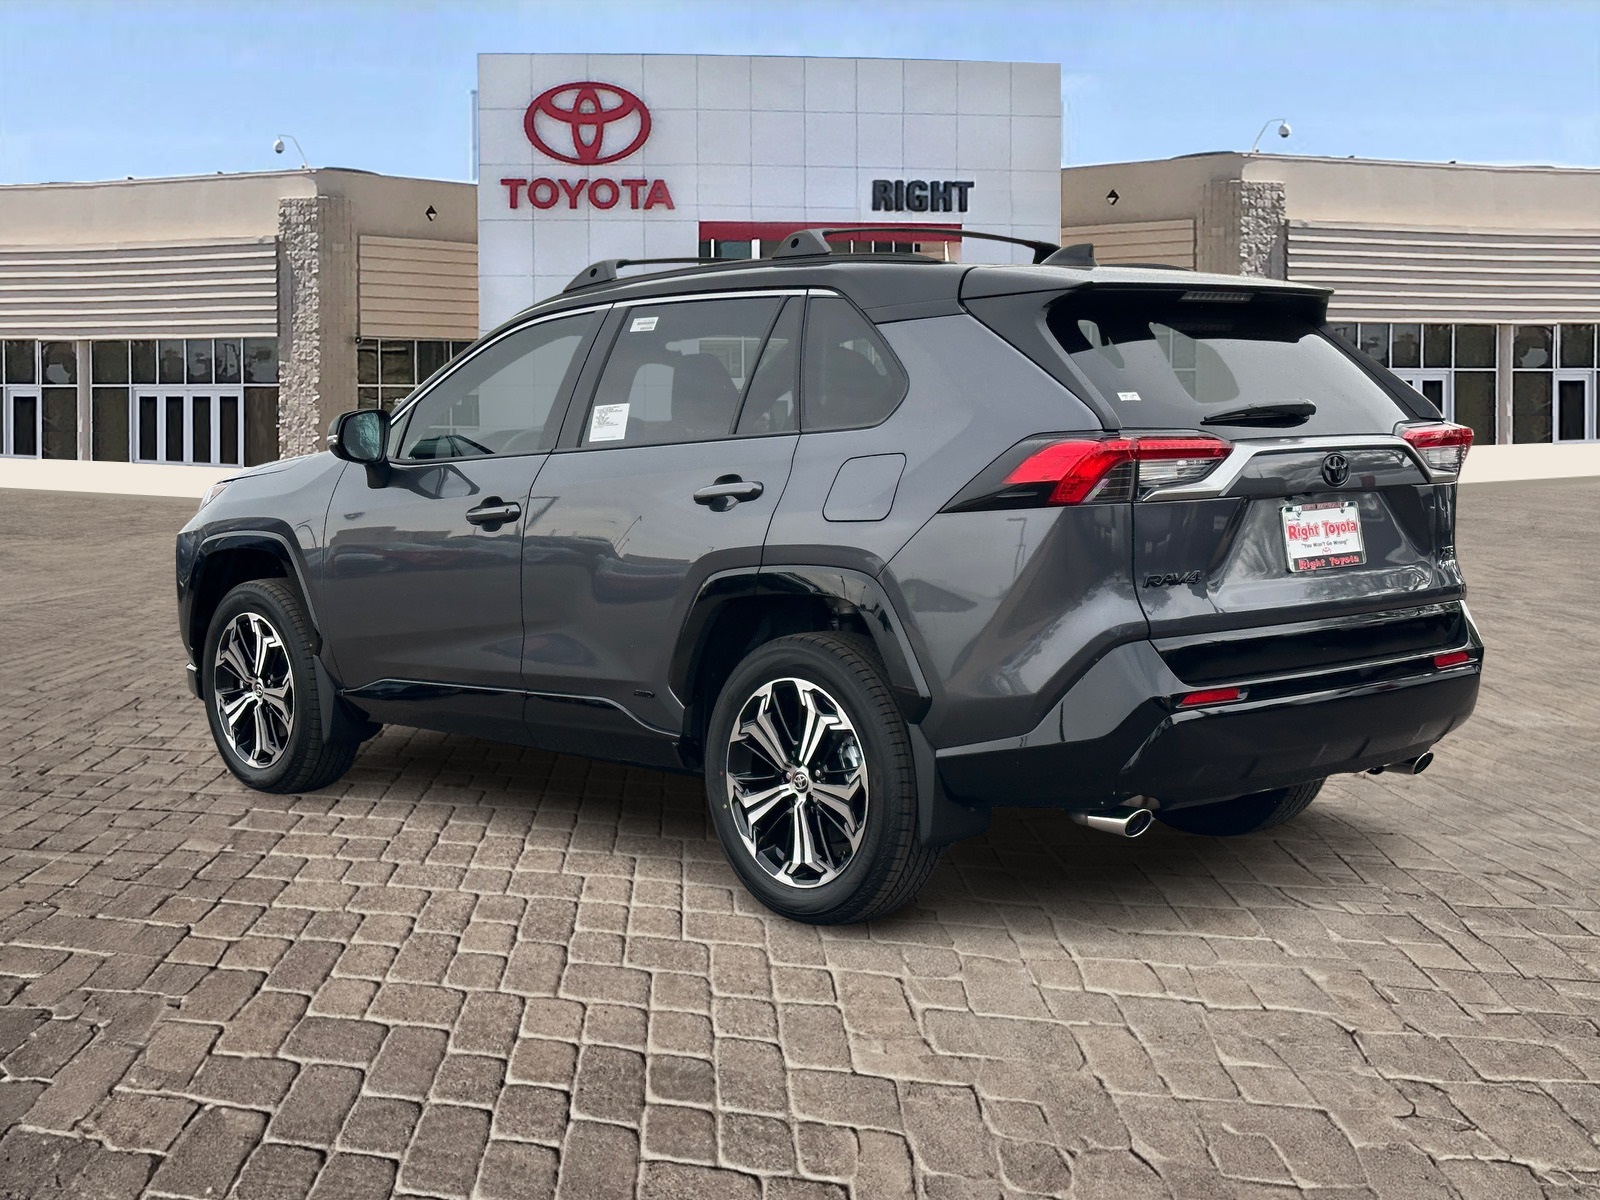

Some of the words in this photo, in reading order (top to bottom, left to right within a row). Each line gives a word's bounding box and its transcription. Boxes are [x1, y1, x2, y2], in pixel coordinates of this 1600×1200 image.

[500, 177, 675, 210] TOYOTA
[872, 179, 974, 212] RIGHT
[1287, 521, 1319, 542] Right
[1322, 519, 1358, 538] Toyota
[1298, 558, 1326, 570] Right
[1329, 555, 1360, 567] Toyota
[1143, 569, 1201, 588] RAV4
